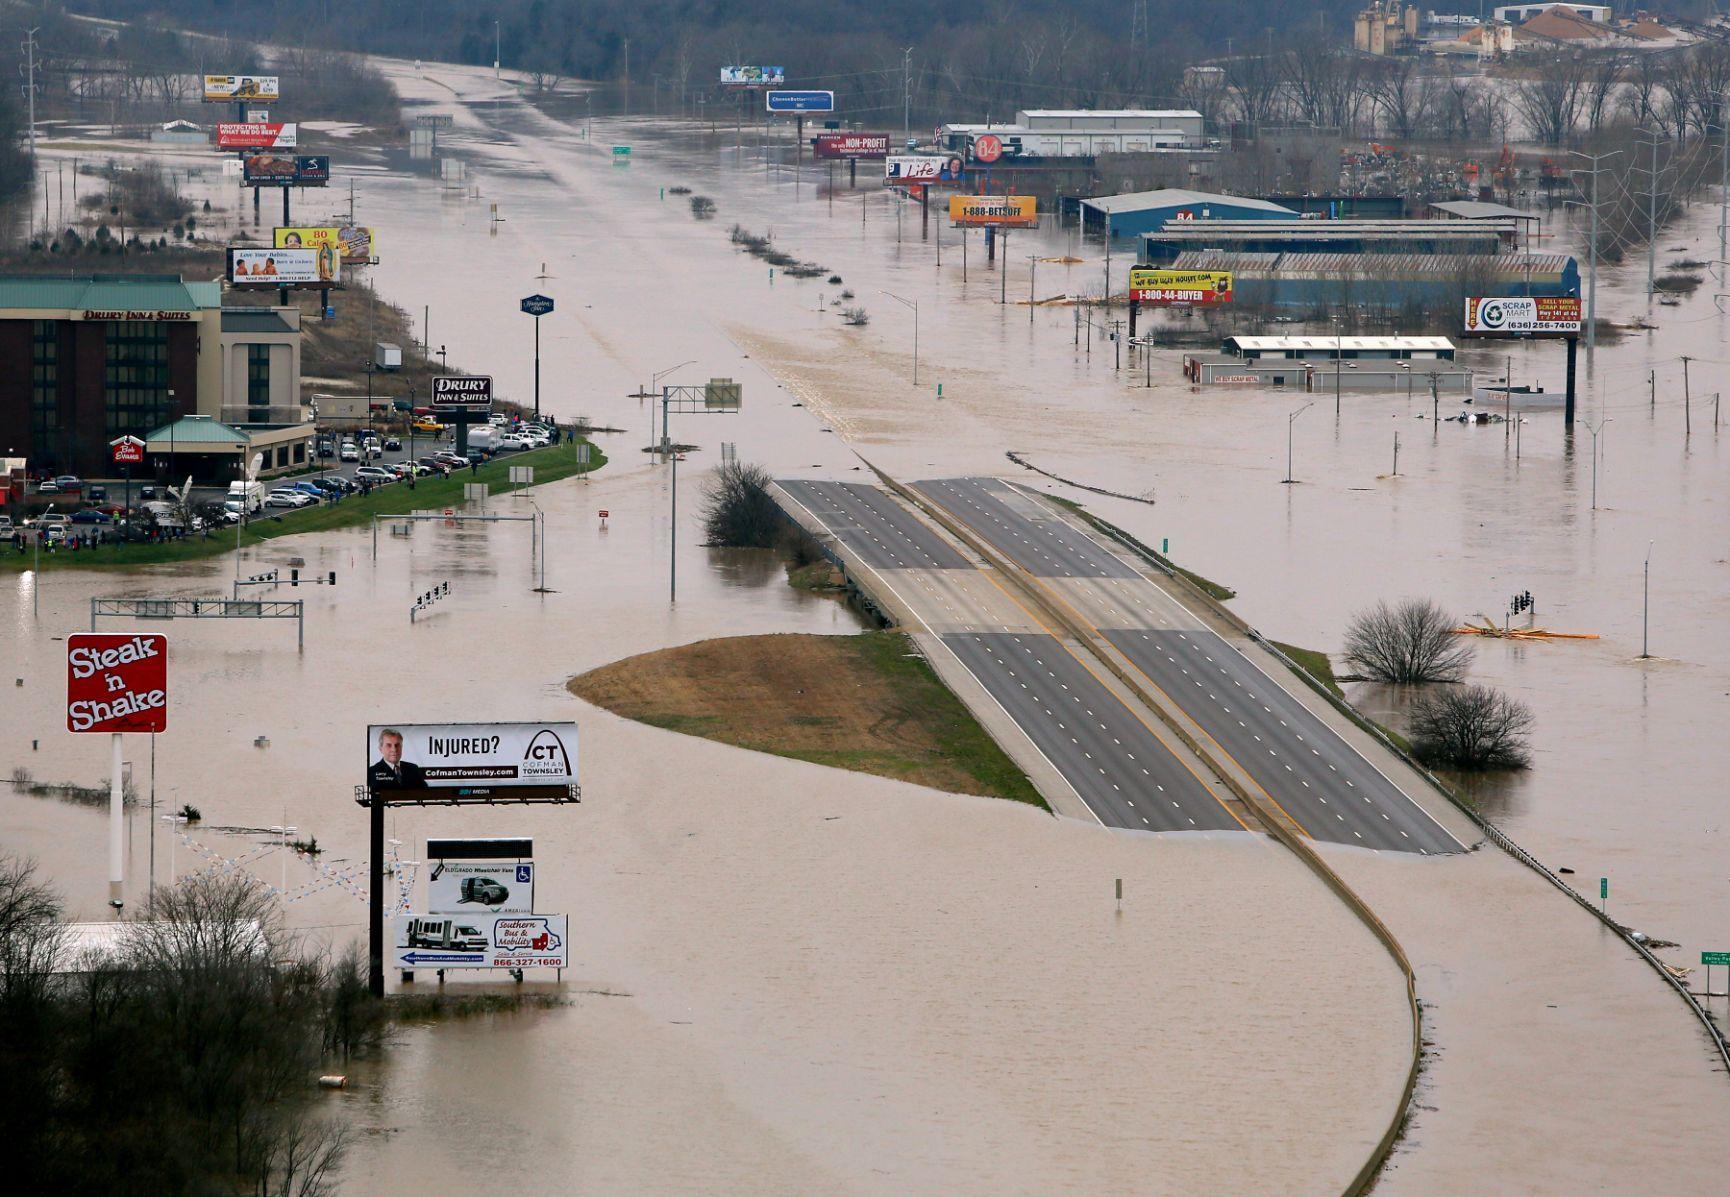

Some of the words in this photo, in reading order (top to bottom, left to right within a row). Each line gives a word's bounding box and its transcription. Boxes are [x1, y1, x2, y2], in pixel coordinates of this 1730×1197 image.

[845, 137, 887, 148] NON-PROFIT
[978, 140, 999, 157] 84
[907, 162, 934, 177] Life
[962, 206, 1022, 216] 1-888-BETSOFF
[1176, 213, 1194, 221] 84
[313, 230, 328, 238] 80
[1138, 289, 1203, 300] 1-800-44-BUYER
[1502, 302, 1532, 310] SCRAP
[83, 310, 123, 320] DRURY
[125, 310, 147, 320] INN
[156, 310, 191, 320] SUITES
[1508, 321, 1531, 330] (636)
[1532, 321, 1577, 329] 256-7400
[436, 379, 488, 392] DRURY
[436, 393, 452, 402] INN
[460, 392, 489, 402] SUITES
[120, 445, 136, 453] Bob
[115, 451, 140, 460] Evans
[69, 636, 159, 679] Steak
[69, 689, 165, 731] Shake
[429, 735, 500, 758] INJURED?
[532, 745, 558, 760] CT
[425, 768, 514, 778] CofmanTownsley.com
[499, 920, 536, 929] Southern
[504, 929, 519, 937] Bus
[520, 929, 528, 937] &
[498, 936, 532, 947] Mobility
[493, 958, 562, 966] 866-327-1600
